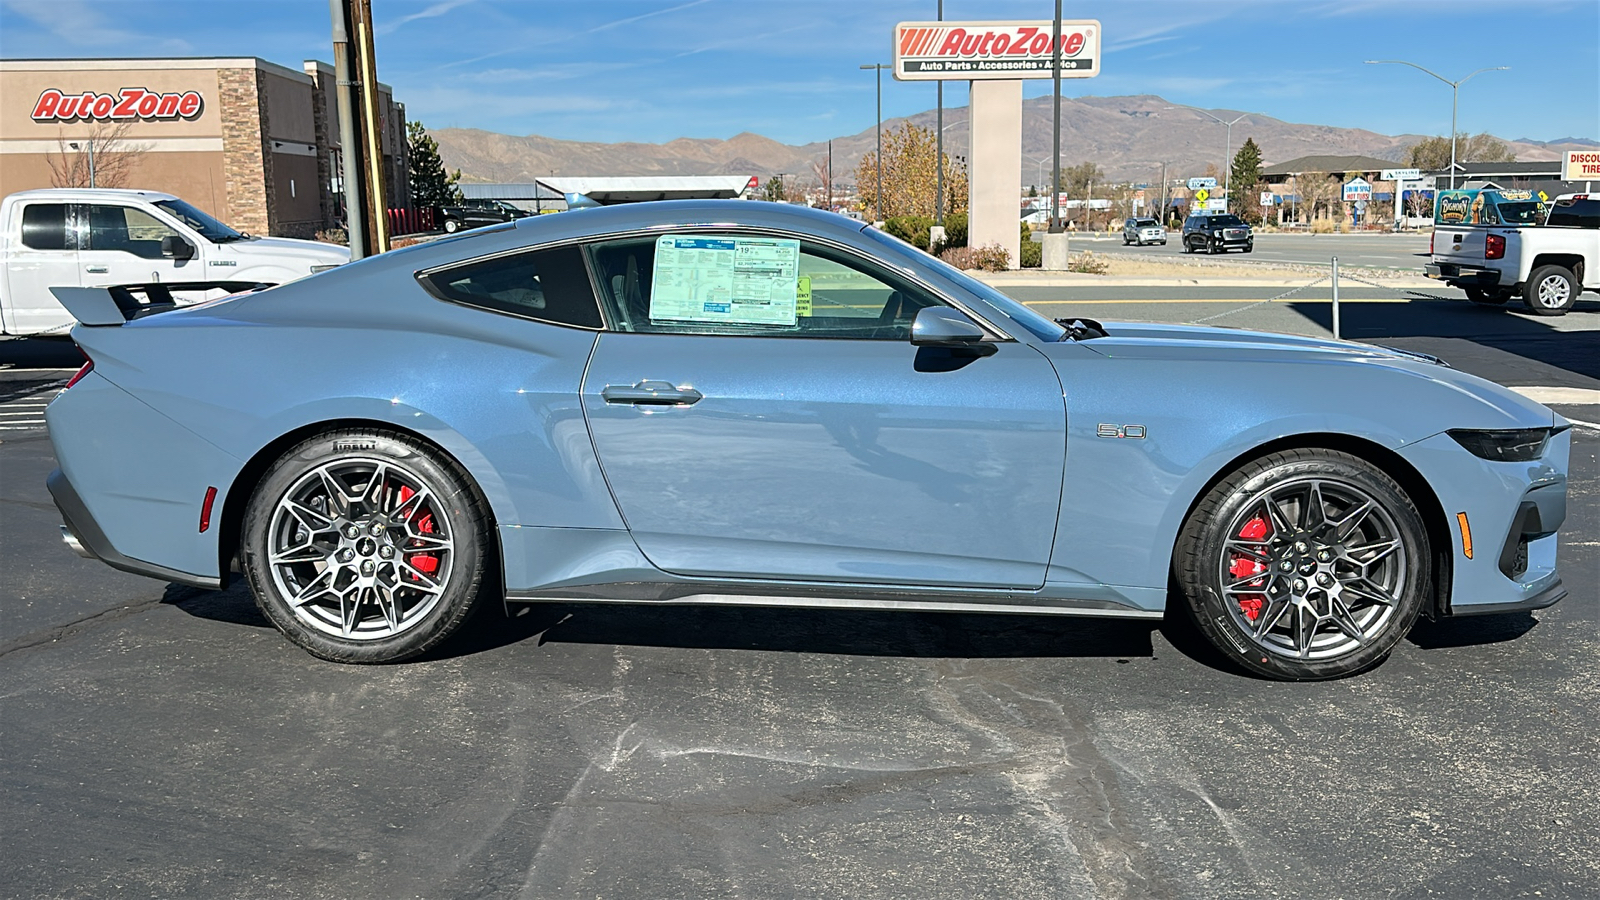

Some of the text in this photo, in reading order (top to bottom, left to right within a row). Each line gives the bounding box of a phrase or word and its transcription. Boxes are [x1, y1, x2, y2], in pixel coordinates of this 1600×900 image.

[920, 62, 943, 70] Auto
[945, 61, 971, 70] Parts
[978, 60, 1037, 70] Accessories
[32, 88, 203, 121] AutoZone
[740, 247, 750, 255] 19
[1096, 423, 1147, 439] 5.0
[333, 440, 377, 452] PIRELLI
